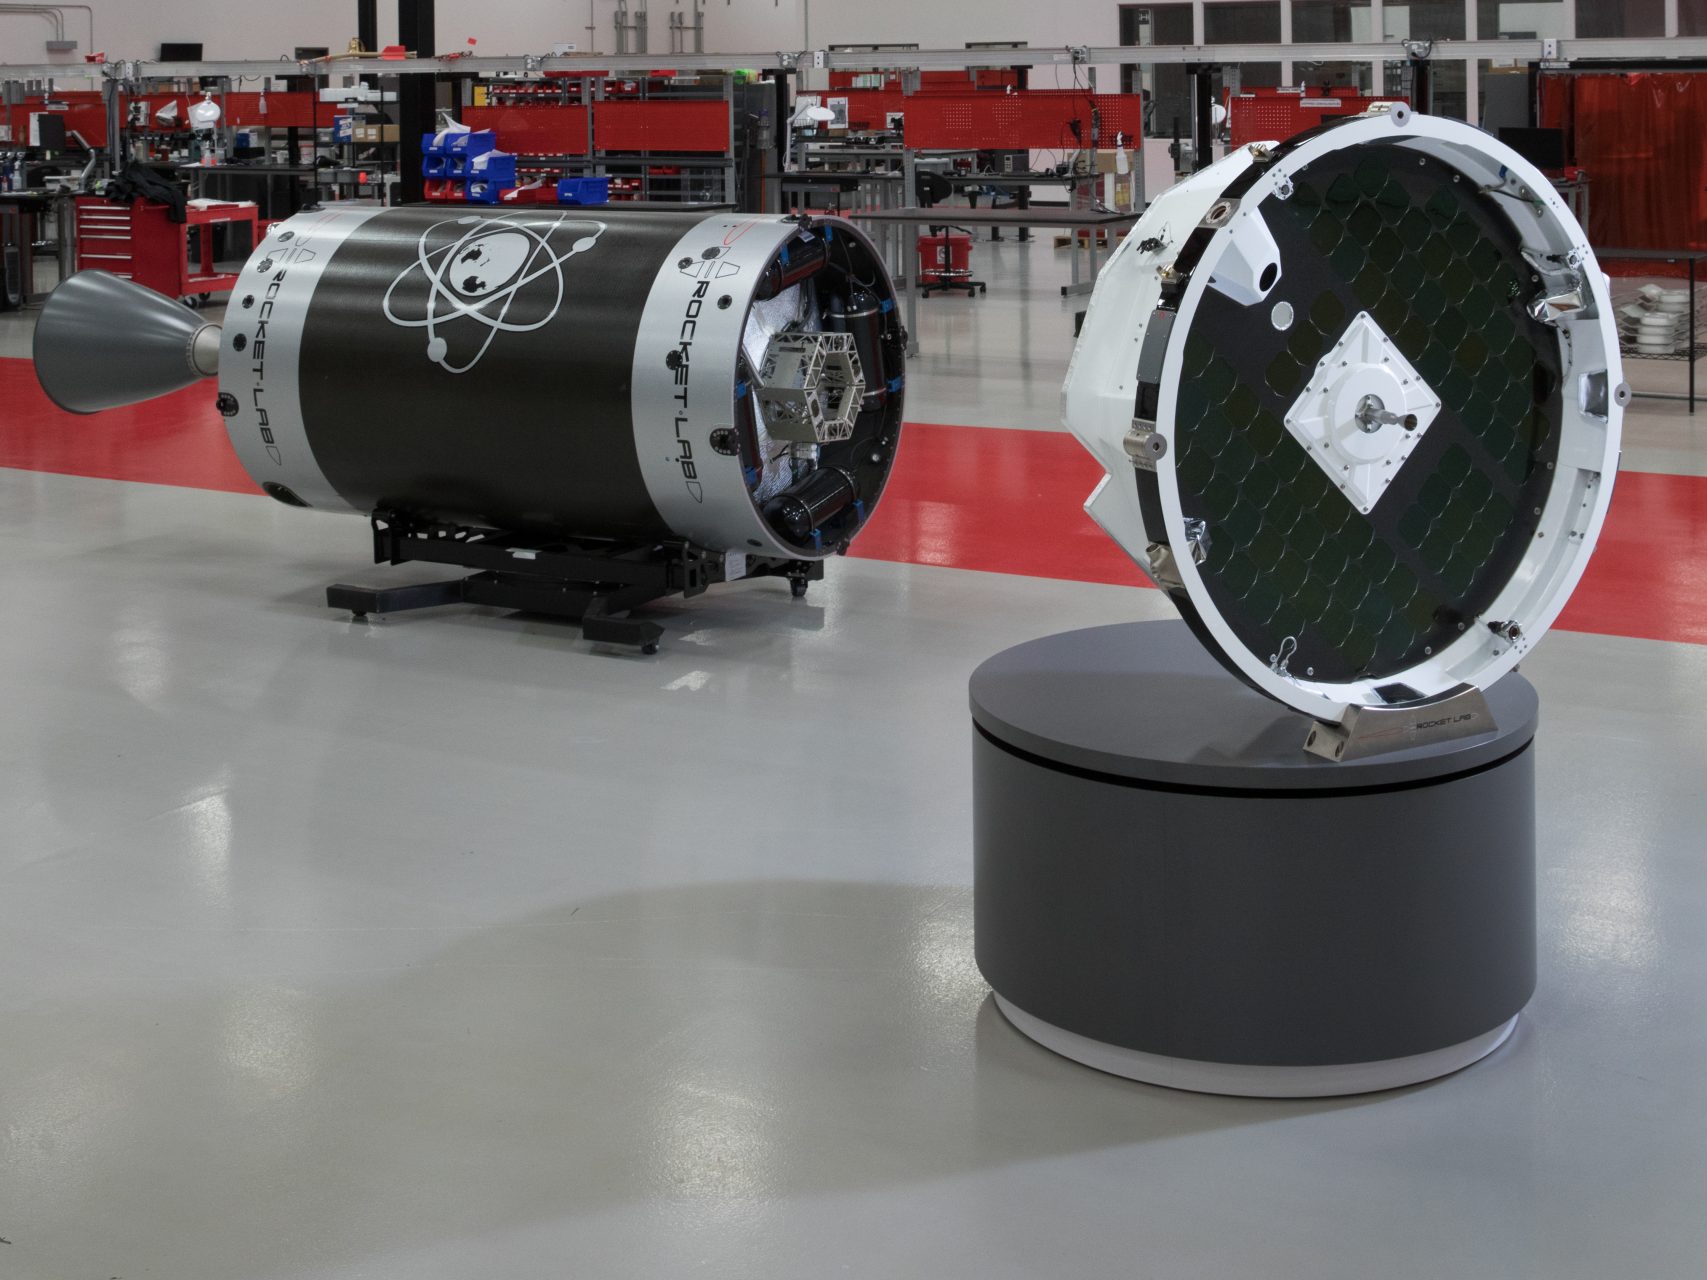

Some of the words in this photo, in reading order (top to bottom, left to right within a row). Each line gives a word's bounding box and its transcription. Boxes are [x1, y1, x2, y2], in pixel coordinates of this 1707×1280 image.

[252, 269, 287, 380] ROCKET
[674, 281, 710, 408] ROCKET
[253, 388, 275, 444] LAB
[675, 417, 698, 480] LAB
[1416, 718, 1452, 729] ROCKET
